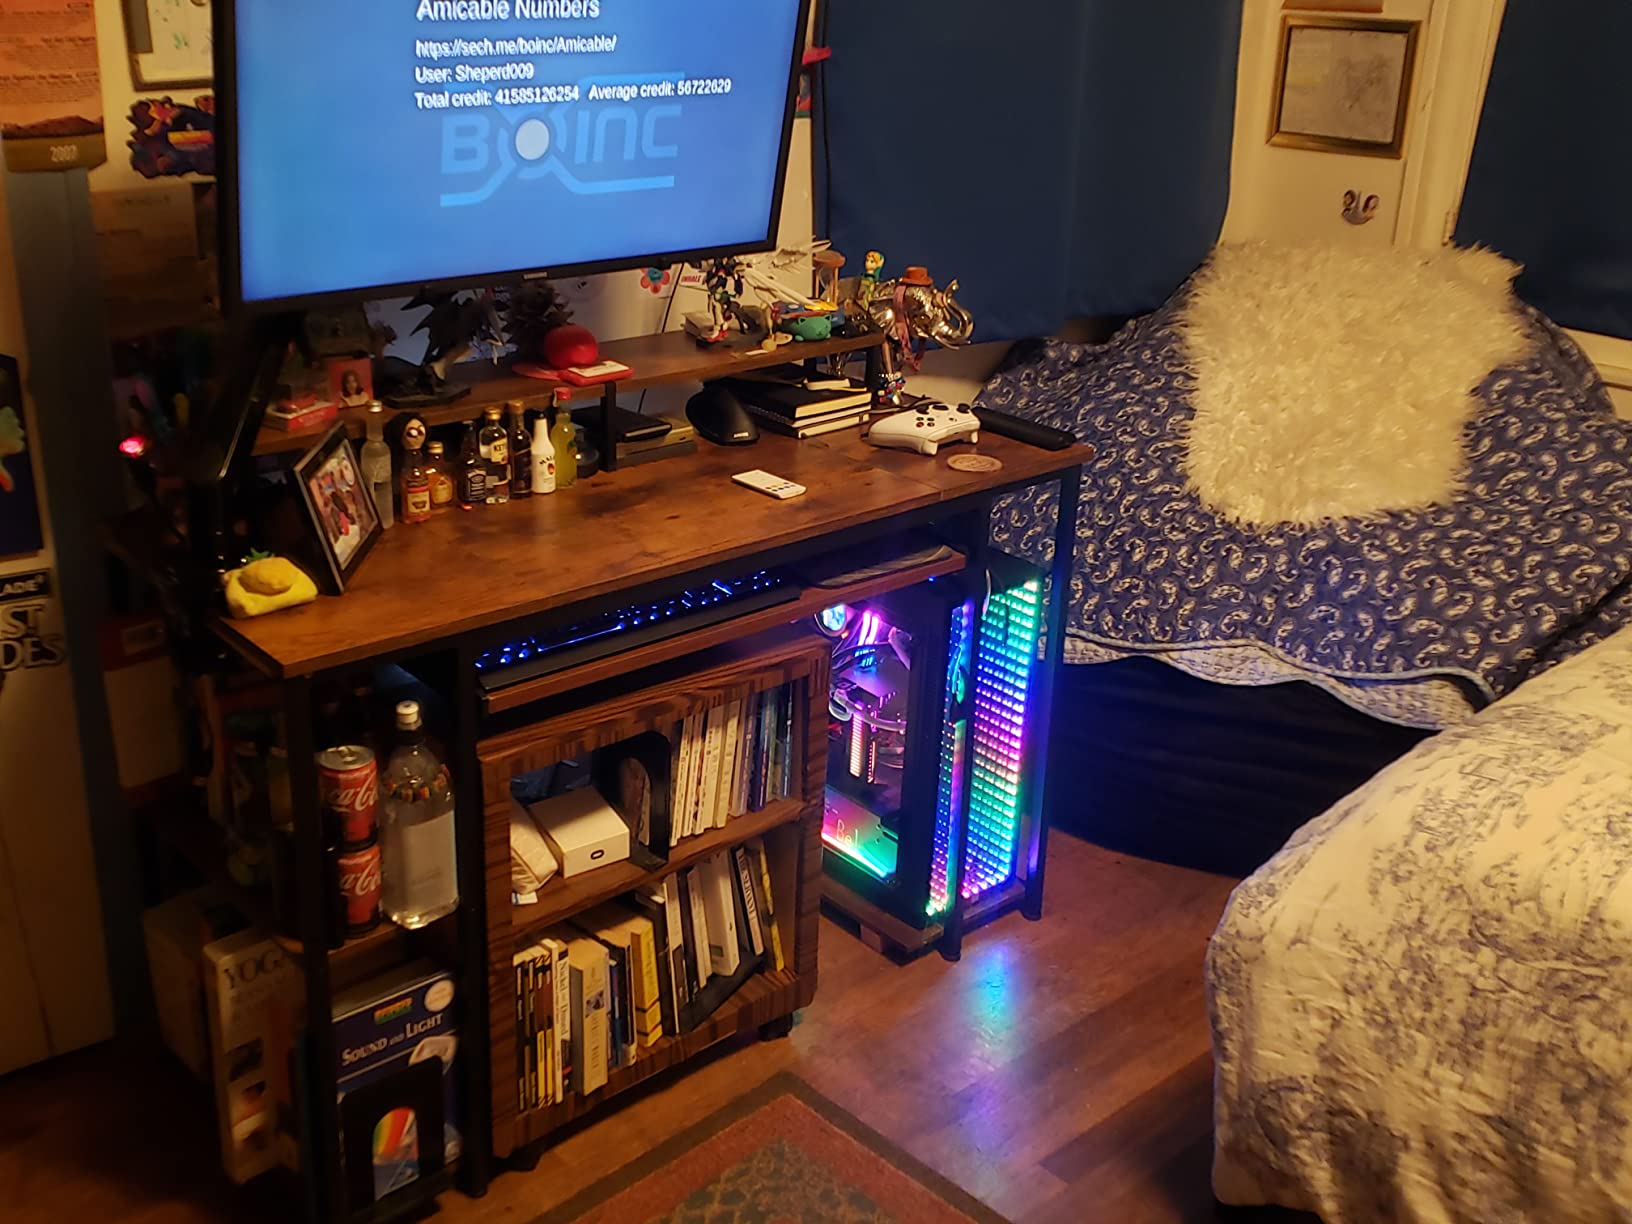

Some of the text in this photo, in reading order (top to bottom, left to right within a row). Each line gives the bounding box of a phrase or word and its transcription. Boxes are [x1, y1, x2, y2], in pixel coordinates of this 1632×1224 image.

[416, 0, 601, 21] Amicable Numbers
[415, 35, 618, 60] https://sech.me/boinc/Amicable/
[415, 63, 535, 84] User: Sheperd009
[414, 90, 449, 109] Total
[452, 89, 492, 107] credit:
[588, 84, 638, 102] Average
[640, 80, 675, 98] credit:
[341, 1037, 389, 1067] SOUND
[404, 1013, 444, 1039] LIGHT
